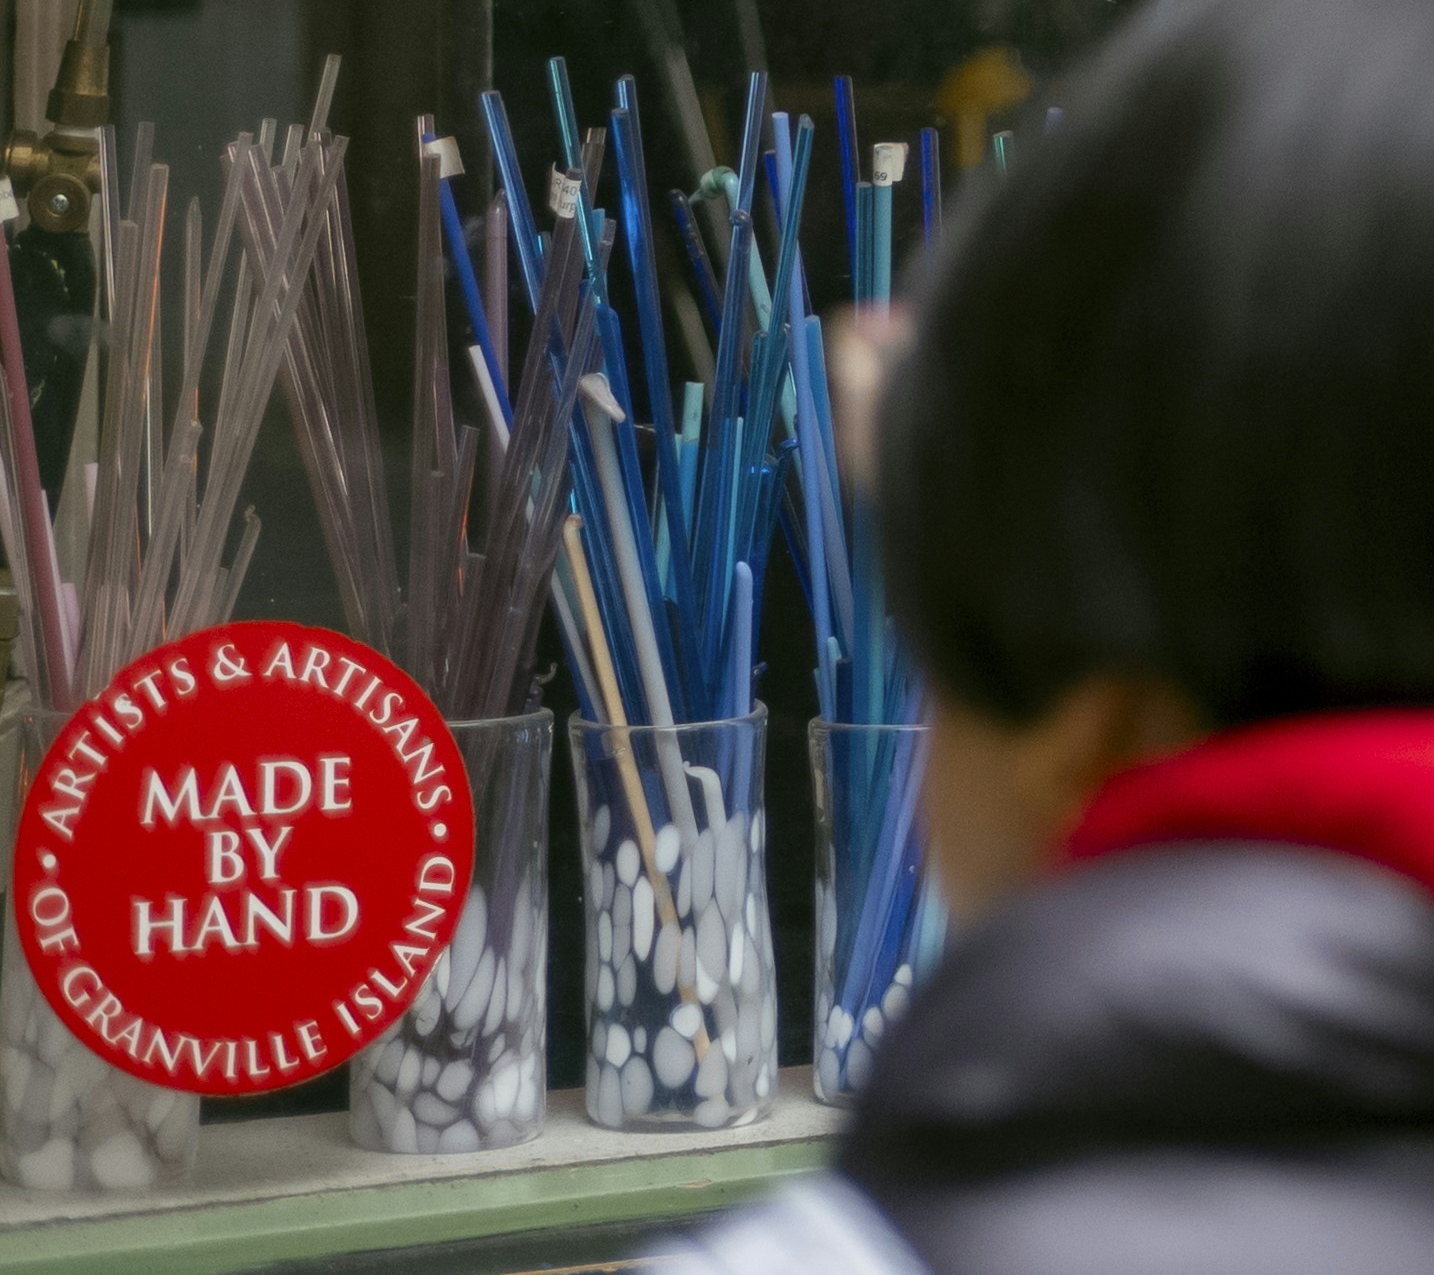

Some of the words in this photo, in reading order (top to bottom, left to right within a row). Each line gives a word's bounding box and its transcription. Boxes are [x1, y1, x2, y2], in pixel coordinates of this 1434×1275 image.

[41, 657, 197, 840] ARTISTS
[212, 643, 252, 682] &
[263, 641, 454, 812] ARTISANS
[140, 755, 353, 826] MADE
[207, 825, 294, 885] BY
[134, 884, 360, 955] HAND
[32, 886, 85, 952] OF
[62, 964, 329, 1079] GRANVILLE
[334, 854, 457, 1036] ISLAND
